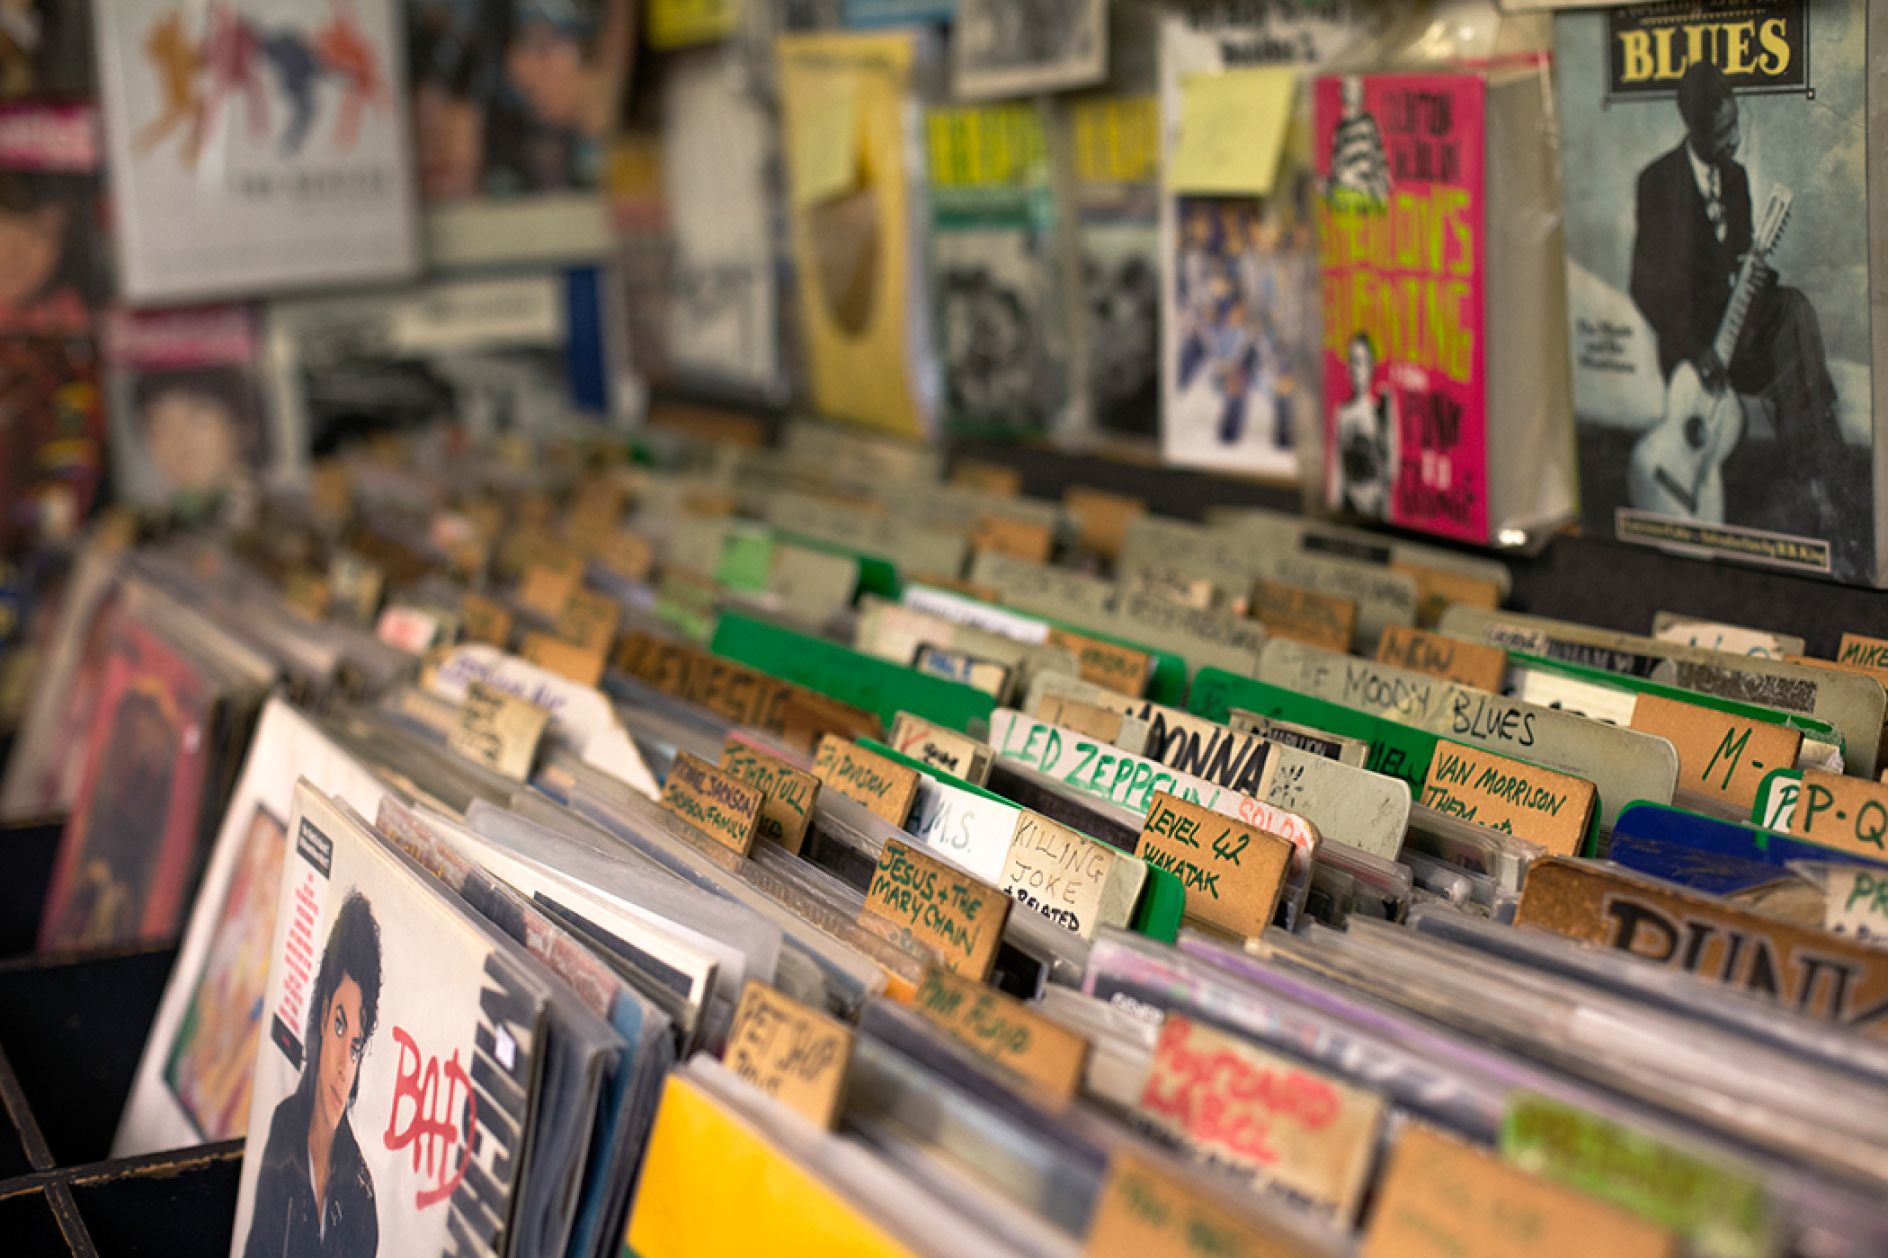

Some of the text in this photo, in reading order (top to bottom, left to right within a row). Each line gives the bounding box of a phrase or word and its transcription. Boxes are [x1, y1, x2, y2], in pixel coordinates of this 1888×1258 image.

[1618, 18, 1791, 83] BLUES
[1001, 715, 1062, 773] LED
[1452, 687, 1536, 747] BLUES
[1127, 703, 1272, 799] DONNA
[1437, 752, 1567, 817] VAN MORRISON
[1012, 814, 1104, 884] KILLING
[1144, 799, 1250, 866] LEVEL 42
[879, 845, 938, 900] JESUS
[1009, 860, 1082, 905] JOKE
[871, 874, 924, 925] MARY
[923, 903, 982, 957] CHAIN
[384, 1026, 477, 1210] BAD
